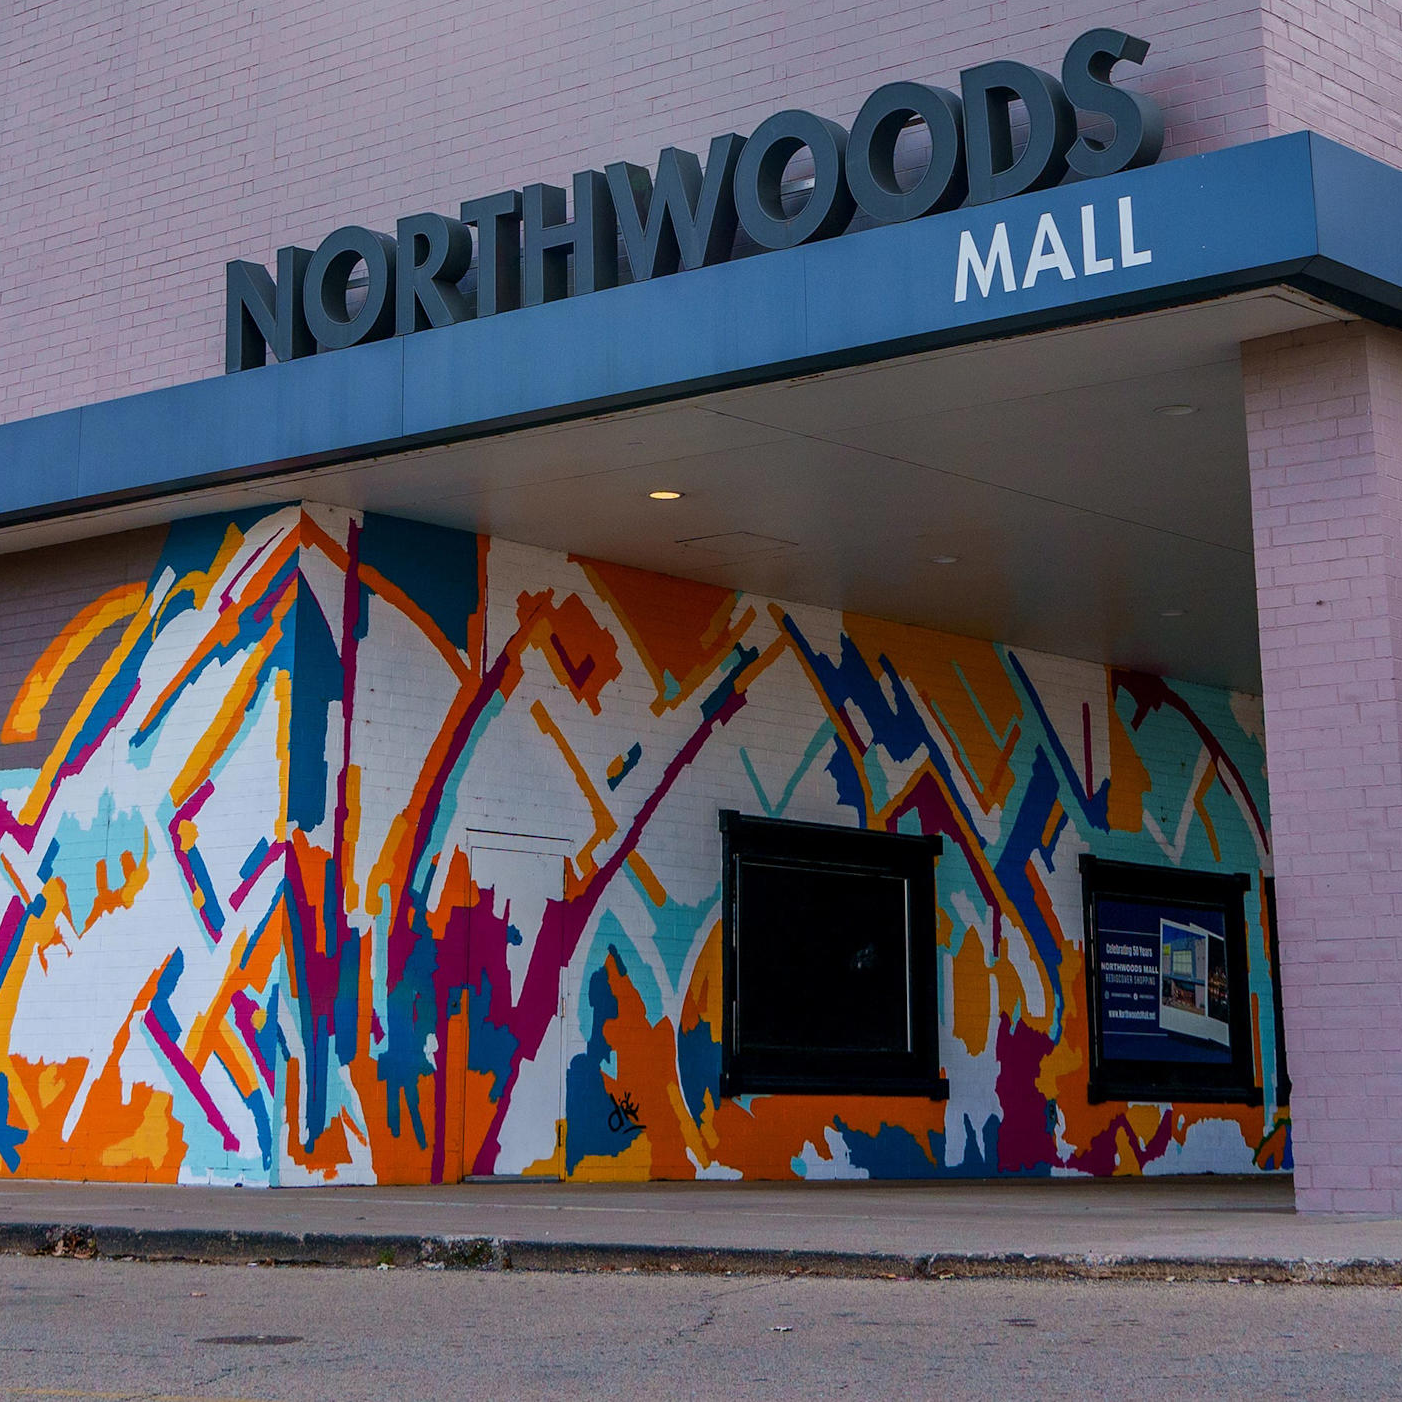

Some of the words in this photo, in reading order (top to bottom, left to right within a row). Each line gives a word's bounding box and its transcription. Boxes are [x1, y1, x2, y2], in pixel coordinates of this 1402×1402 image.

[226, 28, 1164, 373] NORTHWOODS
[954, 196, 1152, 302] MALL
[1106, 943, 1132, 957] Celebrating
[1132, 945, 1139, 957] 50
[1139, 945, 1153, 958] Years
[1101, 961, 1143, 974] NORTHWOODS
[1143, 965, 1159, 975] MALL
[1105, 973, 1133, 985] REDISCOVER
[1133, 975, 1156, 986] SHOPPING
